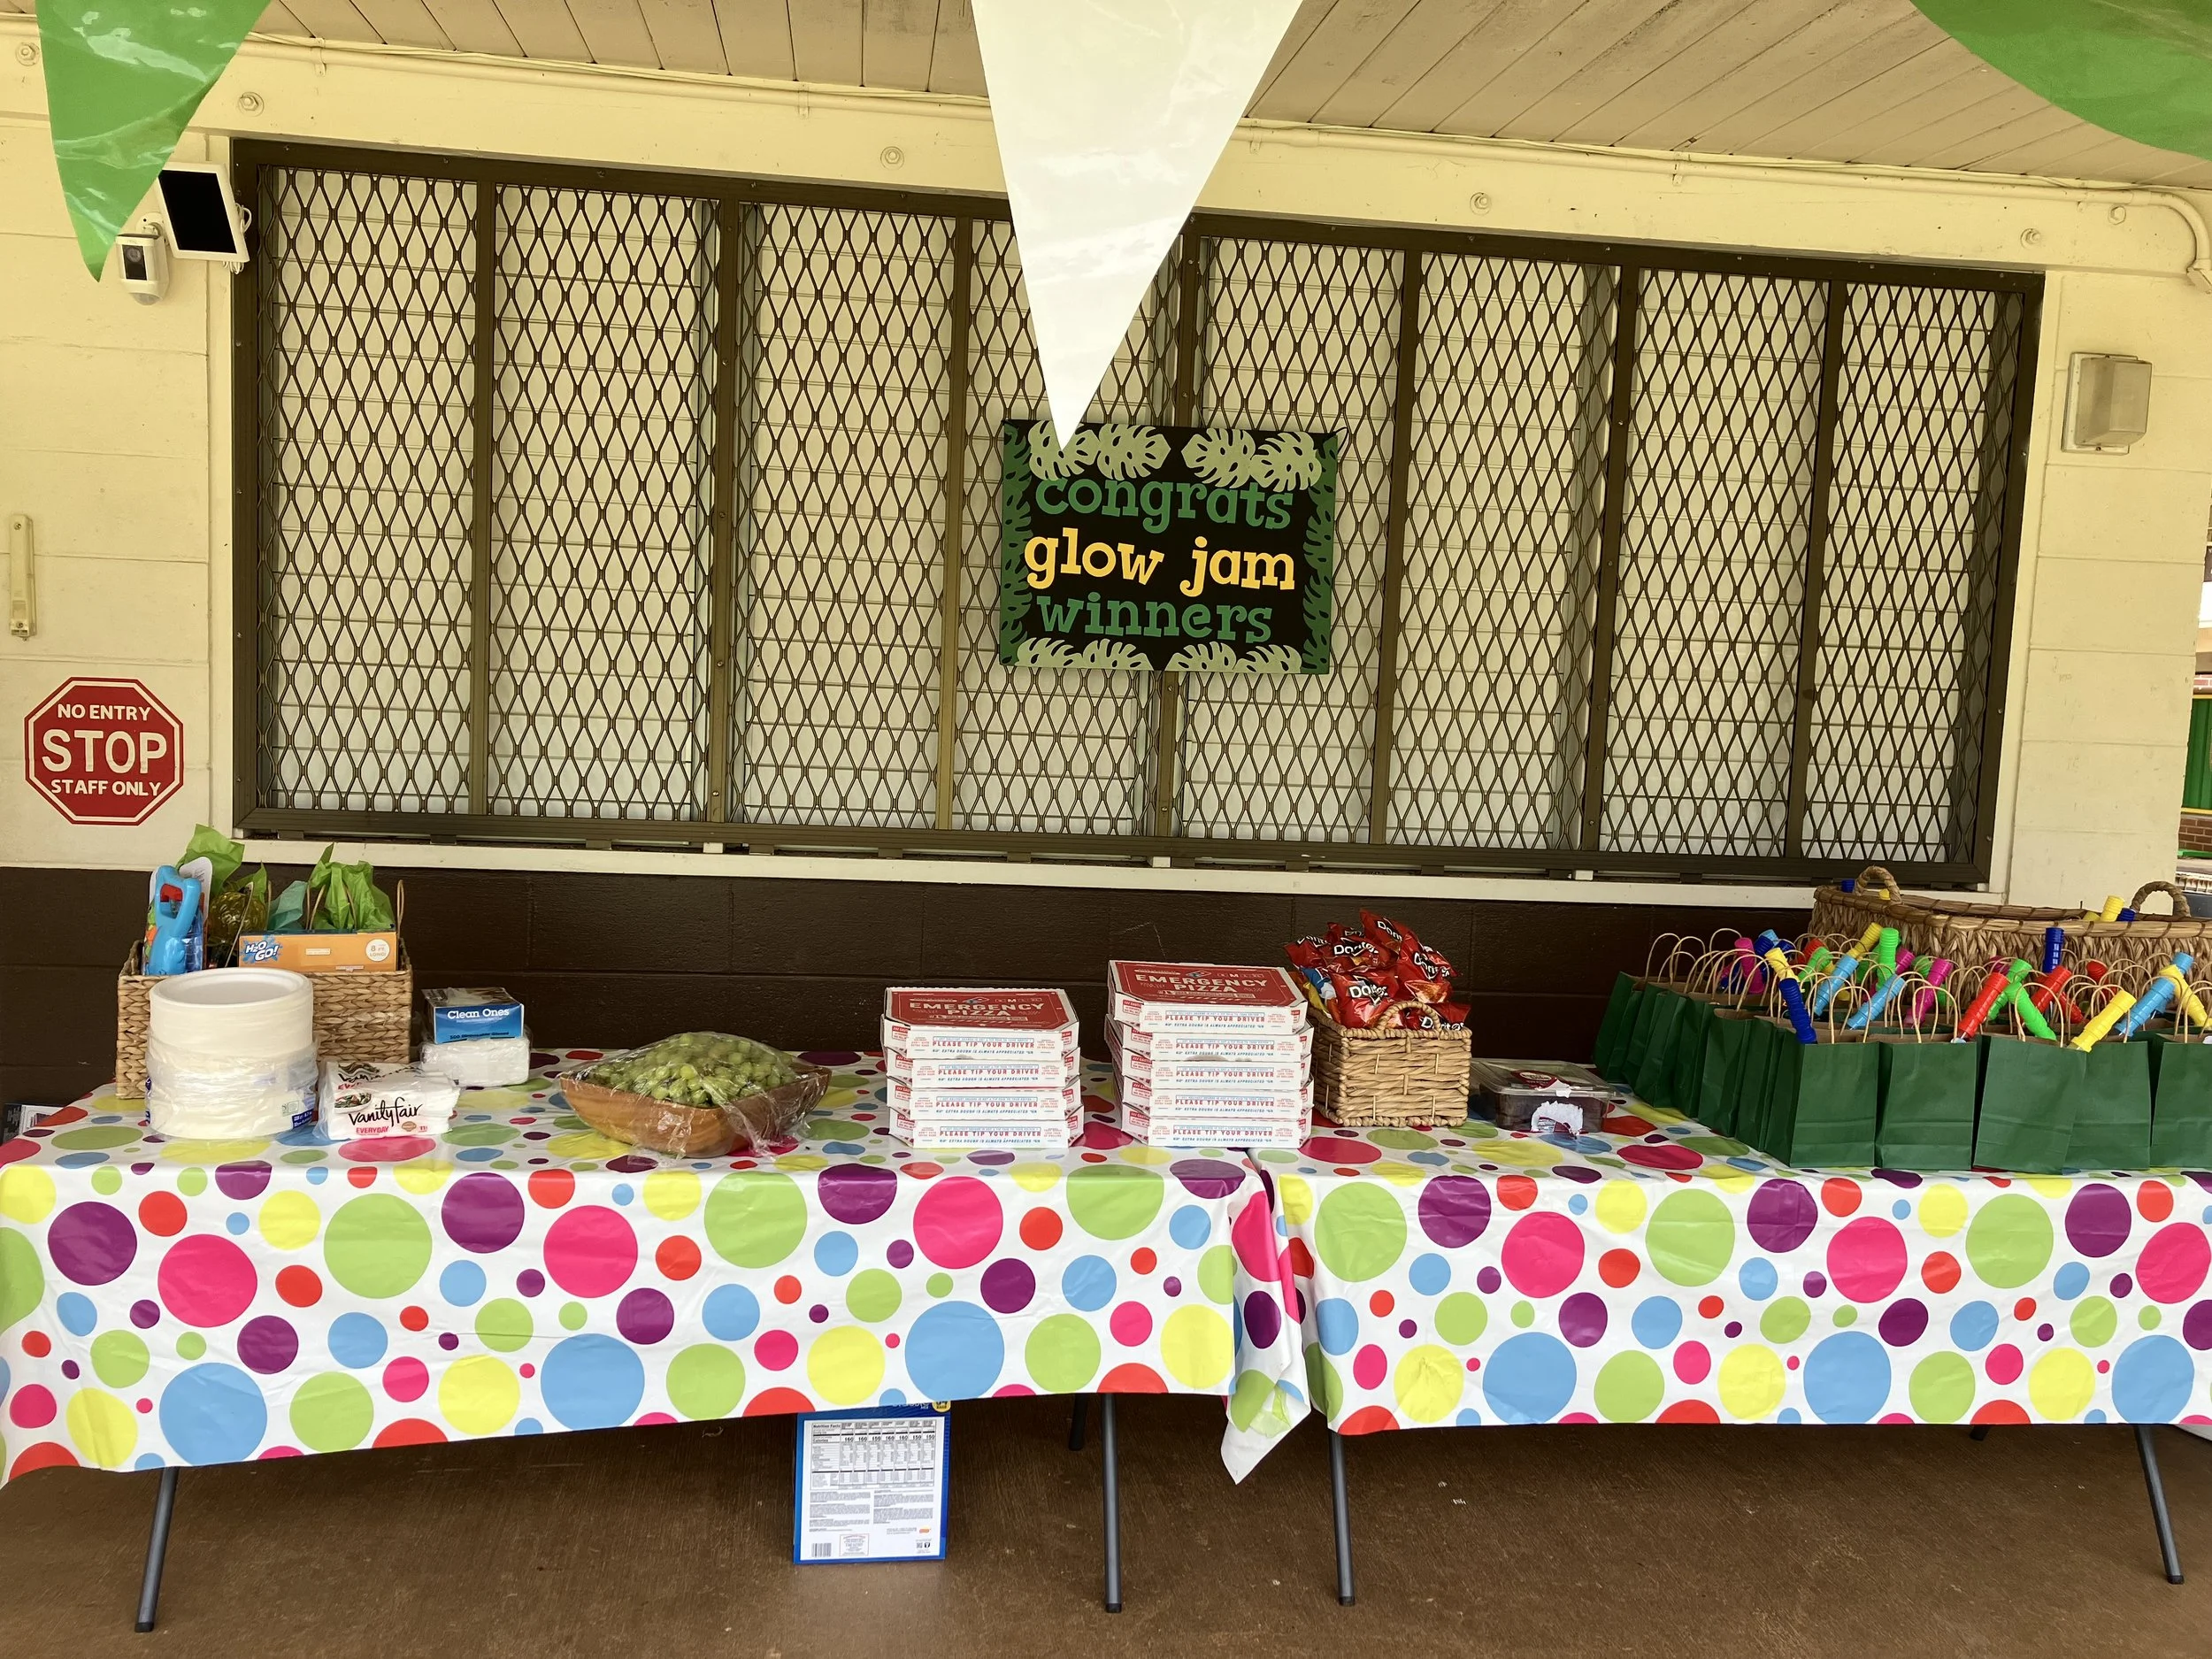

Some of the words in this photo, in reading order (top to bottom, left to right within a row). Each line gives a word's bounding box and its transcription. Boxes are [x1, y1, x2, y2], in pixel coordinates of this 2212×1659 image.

[1035, 477, 1294, 533] congrats
[1024, 527, 1165, 590] glow
[1179, 535, 1295, 597] jam
[1036, 591, 1273, 644] winners
[58, 703, 86, 718] NO
[89, 704, 151, 721] ENTRY
[42, 729, 167, 774] STOP
[50, 780, 109, 795] STAFF
[111, 780, 162, 796] ONLY
[255, 944, 280, 961] GO!
[1135, 975, 1268, 987] EMERGENCY
[1175, 984, 1237, 993] PIZZA
[448, 1010, 480, 1019] Clean
[482, 1008, 510, 1017] Ones
[909, 1002, 1045, 1011] EMERGENCY
